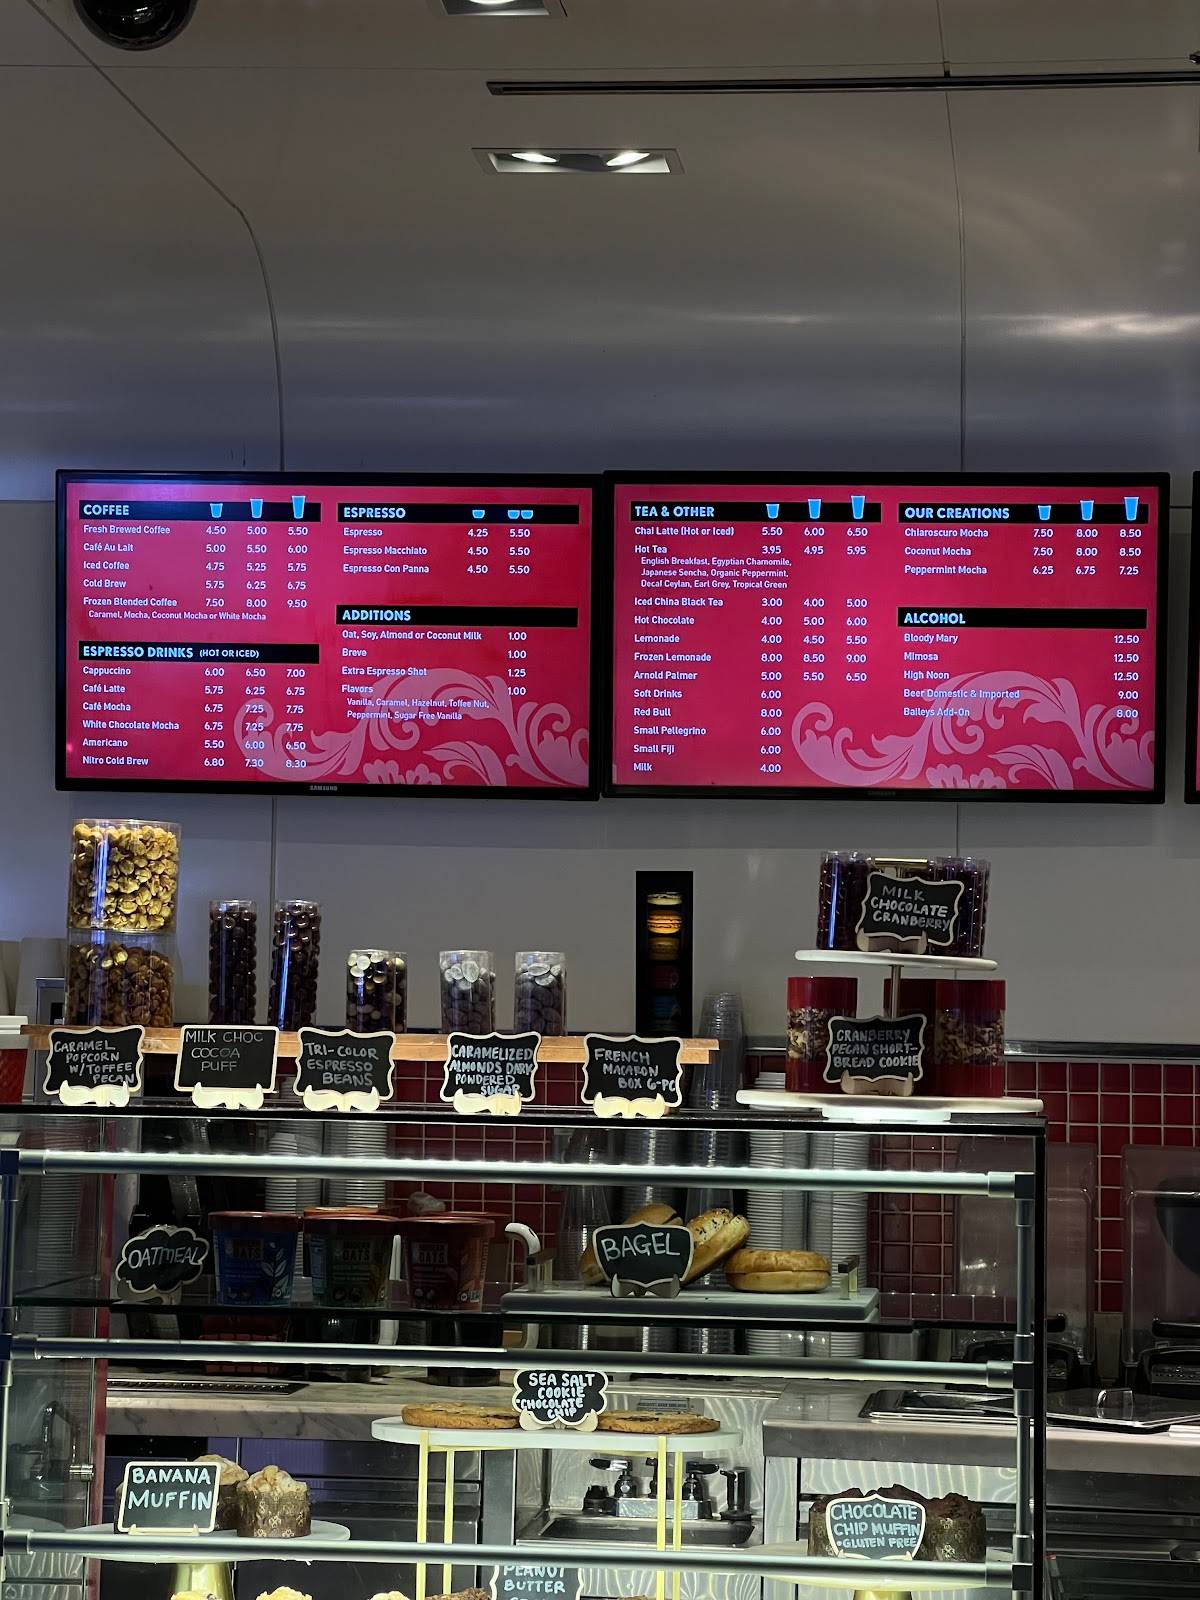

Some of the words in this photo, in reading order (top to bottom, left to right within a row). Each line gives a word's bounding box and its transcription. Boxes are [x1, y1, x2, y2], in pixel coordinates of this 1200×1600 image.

[83, 503, 129, 515] COFFEE
[343, 506, 406, 518] ESPRESSO
[634, 505, 658, 516] TEA
[660, 505, 669, 516] &
[672, 505, 714, 517] OTHER
[904, 506, 933, 518] OUR
[936, 507, 1009, 519] CREATIONS
[83, 524, 107, 533] Fresh
[109, 524, 141, 533] Brewed
[143, 525, 170, 534] Coffee
[205, 525, 226, 534] 4.50
[246, 525, 267, 535] 5.00
[287, 526, 308, 535] 5.50
[343, 526, 382, 538] Espresso
[467, 527, 488, 537] 4.25
[509, 528, 530, 537] 5.50
[634, 526, 654, 535] Chai
[655, 526, 679, 535] Latte
[761, 526, 782, 535] 5.50
[803, 526, 824, 536] 6.00
[846, 527, 868, 536] 6.50
[83, 542, 102, 551] Café
[103, 543, 115, 551] Au
[117, 543, 133, 551] Lait
[205, 543, 225, 552] 5.00
[246, 543, 267, 553] 5.50
[287, 544, 307, 553] 6.00
[904, 546, 940, 555] Coconut
[942, 546, 971, 555] Mocha
[1033, 546, 1053, 556] 7.50
[1075, 547, 1097, 556] 8.00
[1119, 547, 1141, 556] 8.50
[83, 560, 100, 569] Iced
[102, 560, 129, 569] Coffee
[205, 561, 224, 570] 4.75
[246, 562, 266, 571] 5.25
[287, 562, 306, 571] 5.75
[640, 556, 669, 566] English
[711, 556, 744, 567] Egyptian
[83, 578, 102, 587] Cold
[104, 578, 126, 587] Brew
[205, 579, 224, 589] 5.75
[245, 580, 266, 589] 6.25
[287, 580, 306, 590] 6.75
[83, 596, 112, 605] Frozen
[113, 596, 148, 606] Blended
[149, 597, 177, 606] Coffee
[205, 597, 224, 607] 7.50
[245, 598, 267, 607] 8.00
[286, 598, 307, 608] 9.50
[123, 610, 150, 619] Mocha,
[151, 610, 181, 619] Coconut
[183, 611, 208, 619] Mocha
[218, 611, 240, 619] White
[241, 611, 266, 620] Mocha
[341, 609, 411, 621] ADDITIONS
[903, 612, 965, 624] ALCOHOL
[360, 629, 378, 640] Soy,
[379, 630, 413, 639] Almond
[426, 630, 461, 639] Coconut
[462, 631, 482, 640] Milk
[507, 631, 527, 640] 1.00
[634, 633, 680, 642] Lemonade
[760, 634, 782, 643] 4.00
[802, 634, 824, 644] 4.50
[846, 635, 867, 644] 5.50
[903, 632, 934, 644] Bloody
[935, 633, 958, 644] Mary
[1113, 634, 1139, 643] 12.50
[83, 645, 144, 657] ESPRESSO
[147, 646, 193, 658] DRINKS
[199, 648, 219, 657] (HOT
[220, 649, 234, 657] OR
[235, 649, 259, 658] ICED)
[903, 651, 938, 660] Mimosa
[1113, 653, 1139, 662] 12.50
[82, 665, 131, 676] Cappuccino
[204, 667, 224, 676] 6.00
[245, 667, 265, 677] 6.50
[286, 668, 305, 677] 7.00
[633, 670, 663, 679] Arnold
[665, 670, 698, 679] Palmer
[760, 671, 782, 680] 5.00
[803, 671, 824, 681] 5.50
[845, 672, 867, 681] 6.50
[903, 669, 924, 680] High
[925, 670, 949, 679] Noon
[1113, 671, 1139, 681] 12.50
[633, 707, 650, 716] Red
[652, 707, 671, 716] Bull
[760, 708, 782, 717] 8.00
[82, 755, 104, 764] Nitro
[105, 756, 124, 764] Cold
[126, 756, 148, 765] Brew
[633, 762, 652, 771] Milk
[759, 763, 781, 772] 4.00
[881, 884, 925, 902] MILK
[870, 896, 948, 918] CHOCOLATE
[872, 910, 951, 932] CRANBERRY
[185, 1031, 217, 1044] MILK
[222, 1031, 264, 1043] CHOC
[836, 1029, 911, 1043] CRANBERRY
[53, 1040, 116, 1054] CARAMEL
[191, 1047, 241, 1059] COCOA
[303, 1042, 378, 1060] TRI-COLOR
[451, 1044, 534, 1061] CARAMELIZED
[831, 1043, 872, 1056] PECAN
[65, 1051, 120, 1063] POPCORN
[594, 1048, 650, 1065] FRENCH
[833, 1055, 874, 1068] BREAD
[878, 1054, 920, 1068] COOKIE
[69, 1061, 133, 1076] W/TOFFEE
[201, 1060, 237, 1072] PUFF
[306, 1058, 373, 1072] ESPRESSO
[449, 1059, 503, 1075] ALMONDS
[505, 1062, 534, 1076] DARK
[602, 1063, 659, 1077] MACARON
[93, 1072, 135, 1085] PECAN
[322, 1072, 373, 1087] BEANS
[455, 1073, 515, 1085] POWDERED
[618, 1076, 641, 1089] BOX
[646, 1079, 676, 1093] 6-PC
[480, 1084, 521, 1096] SUGAR
[600, 1231, 681, 1262] BAGEL
[127, 1246, 200, 1270] OATMEAL
[528, 1372, 557, 1387] SEA
[560, 1373, 595, 1387] SALT
[537, 1386, 585, 1399] COOKIE
[547, 1407, 577, 1419] CHIP
[132, 1467, 211, 1486] BANANA
[127, 1489, 214, 1511] MUFFIN
[830, 1503, 918, 1521] CHOCOLATE
[833, 1522, 868, 1537] CHIP
[872, 1521, 921, 1539] MUFFIN
[888, 1537, 917, 1549] FREE
[503, 1579, 565, 1594] BUTTER
